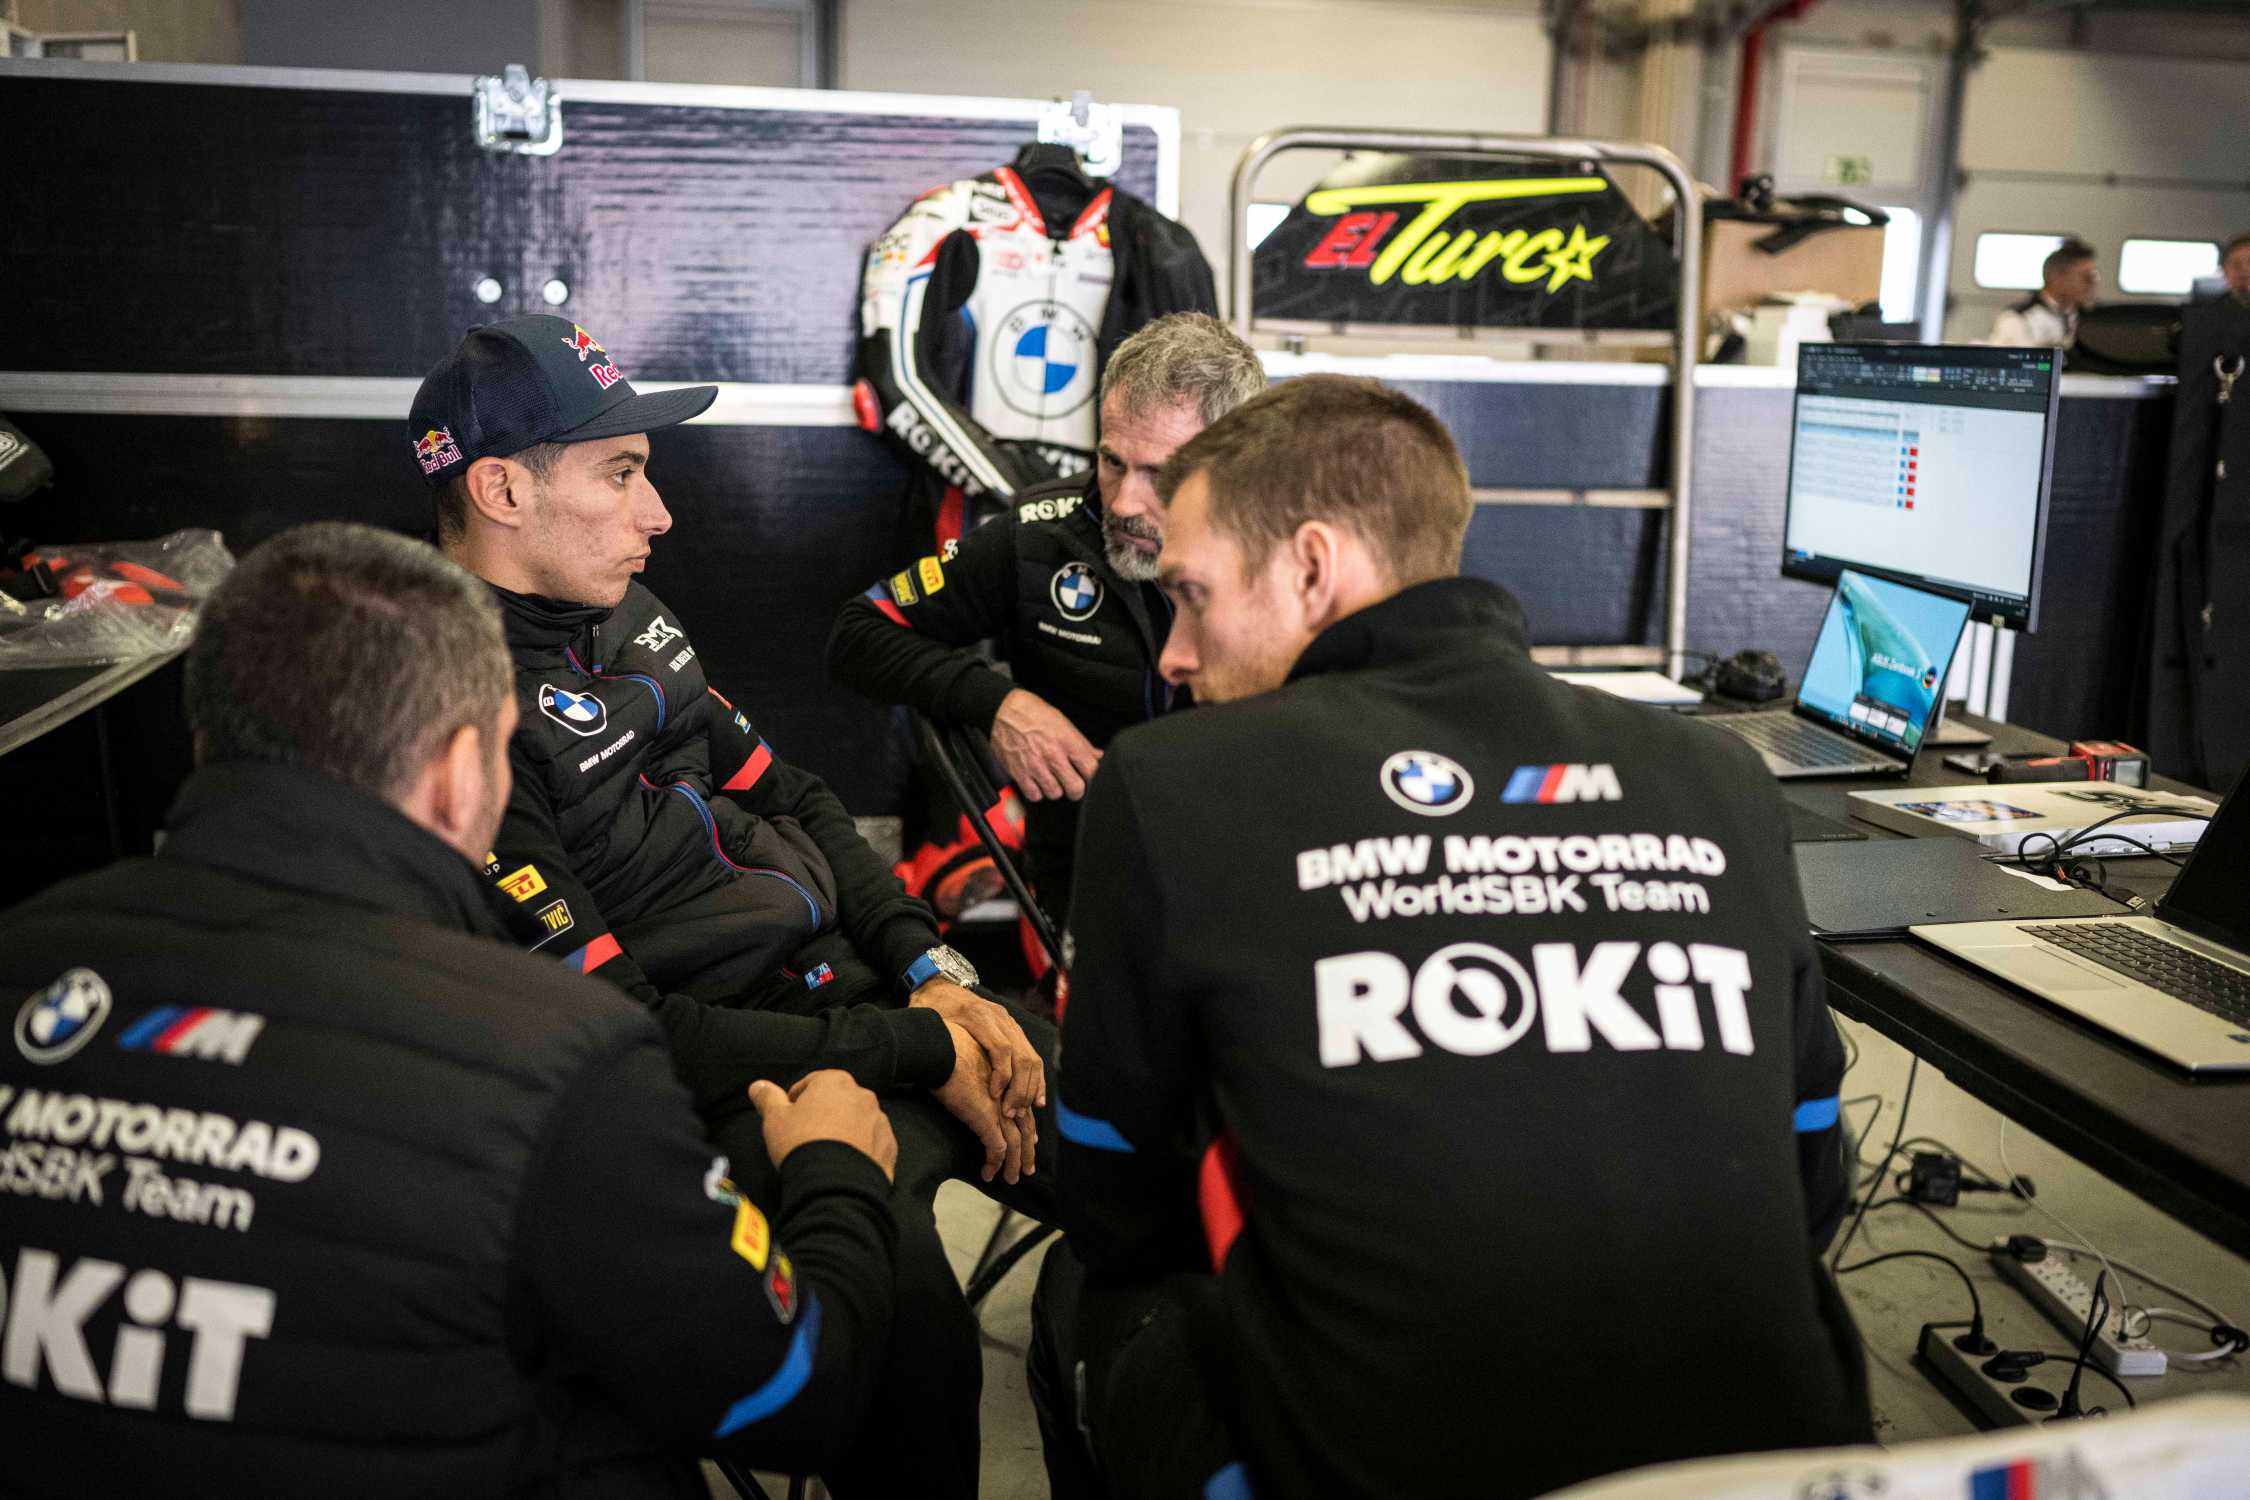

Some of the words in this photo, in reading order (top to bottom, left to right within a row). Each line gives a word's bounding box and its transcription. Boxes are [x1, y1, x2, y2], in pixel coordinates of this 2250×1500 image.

[579, 754, 600, 773] BMW
[600, 730, 635, 760] MOTORRAD
[1297, 834, 1431, 891] BMW
[1444, 833, 1726, 876] MOTORRAD
[1341, 874, 1587, 923] WorldSBK
[1590, 872, 1710, 915] Team
[1314, 941, 1753, 1069] ROKiT
[5, 1088, 321, 1184] MOTORRAD
[123, 1155, 256, 1233] Team
[0, 1246, 277, 1422] KiT
